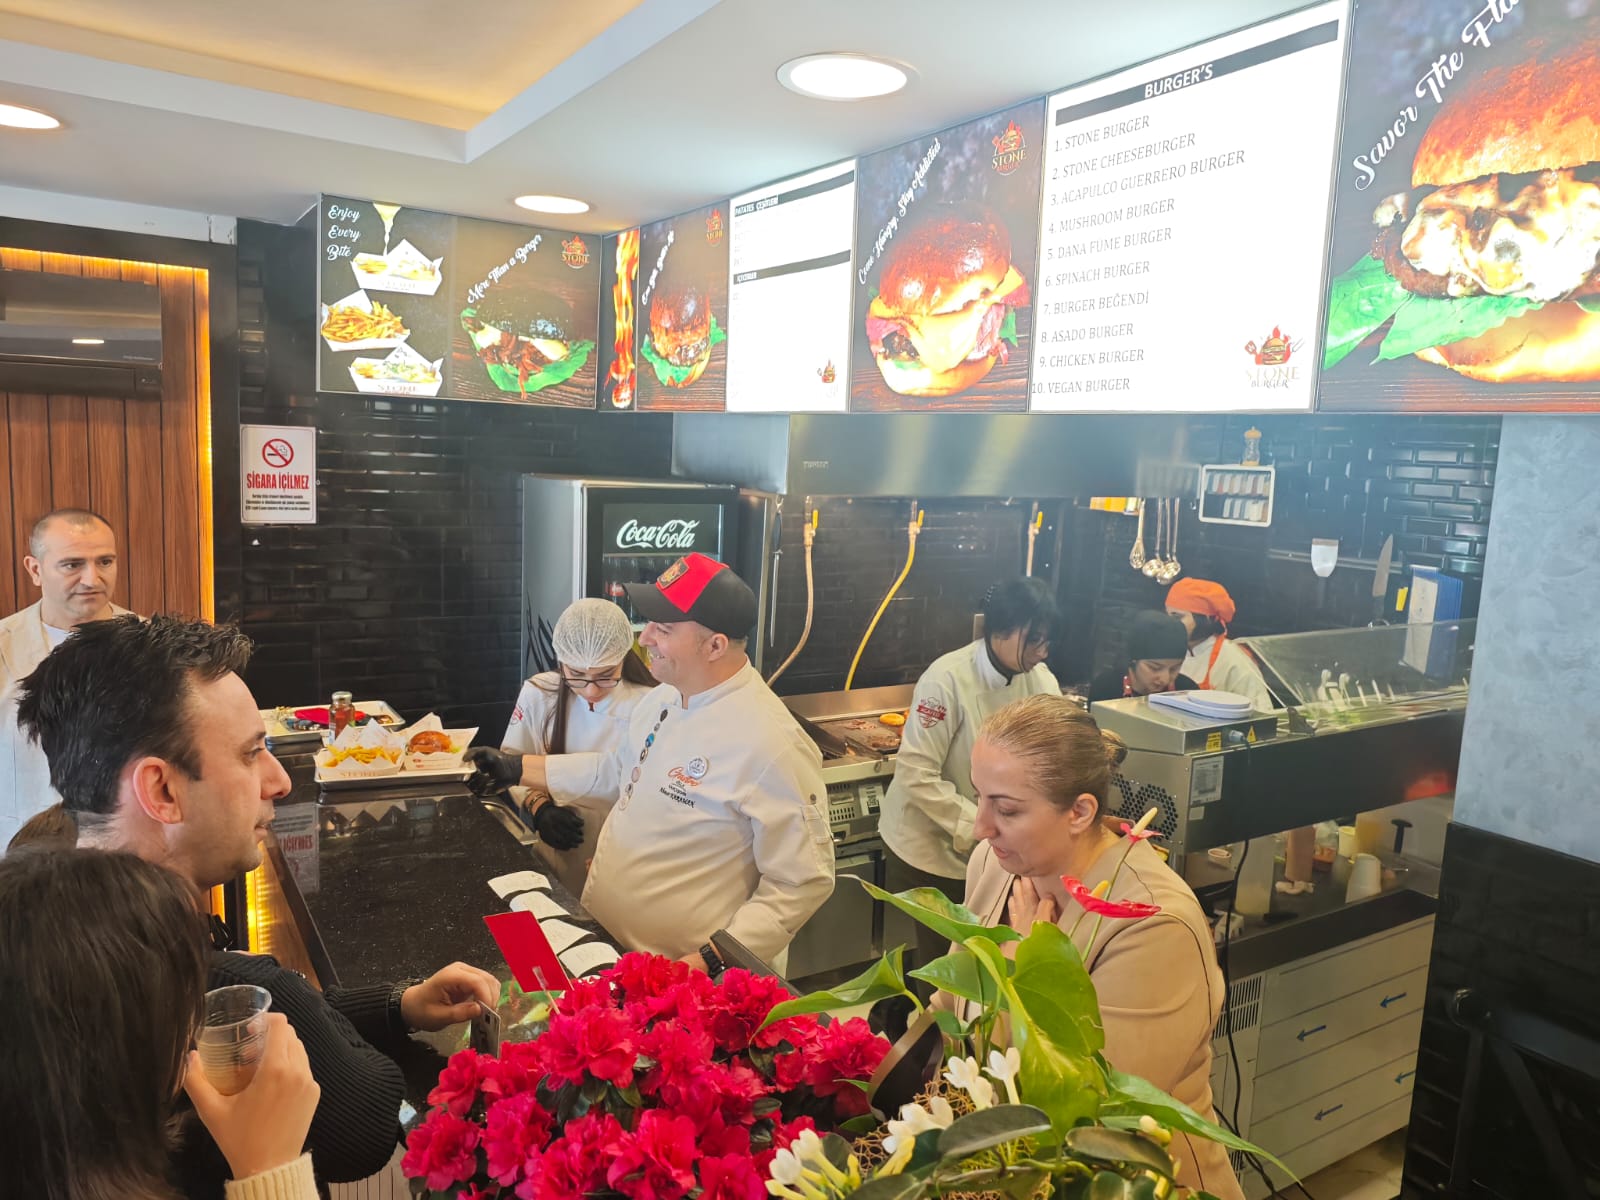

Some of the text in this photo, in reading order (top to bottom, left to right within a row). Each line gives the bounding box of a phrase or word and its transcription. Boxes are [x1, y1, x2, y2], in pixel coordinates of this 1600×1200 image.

[1144, 64, 1213, 99] BURGER'S
[1054, 115, 1150, 152] 1. STONE BURGER
[1353, 104, 1418, 191] Savor
[1416, 51, 1464, 103] The
[992, 150, 1027, 169] STONE
[1052, 132, 1196, 180] 2. STONE CHEESEBURGER
[898, 186, 914, 217] Stay
[911, 137, 941, 188] Addicted
[1050, 150, 1246, 206] 3. ACAPULCO GUERRERO BURGER
[327, 205, 360, 222] Enjoy
[1048, 198, 1175, 234] 4. MUSHROOM BURGER
[327, 225, 361, 242] Every
[1057, 243, 1087, 260] DANA
[1089, 236, 1121, 254] FUME
[1124, 227, 1172, 248] BURGER
[326, 244, 352, 261] Bite
[488, 262, 510, 283] Than
[509, 257, 516, 266] a
[1055, 267, 1101, 287] SPINACH
[1104, 260, 1150, 280] BURGER
[1053, 296, 1096, 315] BURGER
[1041, 323, 1134, 343] 8. ASADO BURGER
[1039, 349, 1144, 368] 9. CHICKEN BURGER
[1031, 378, 1130, 394] 10. VEGAN BURGER
[246, 470, 310, 492] SİGARA İÇİLMEZ
